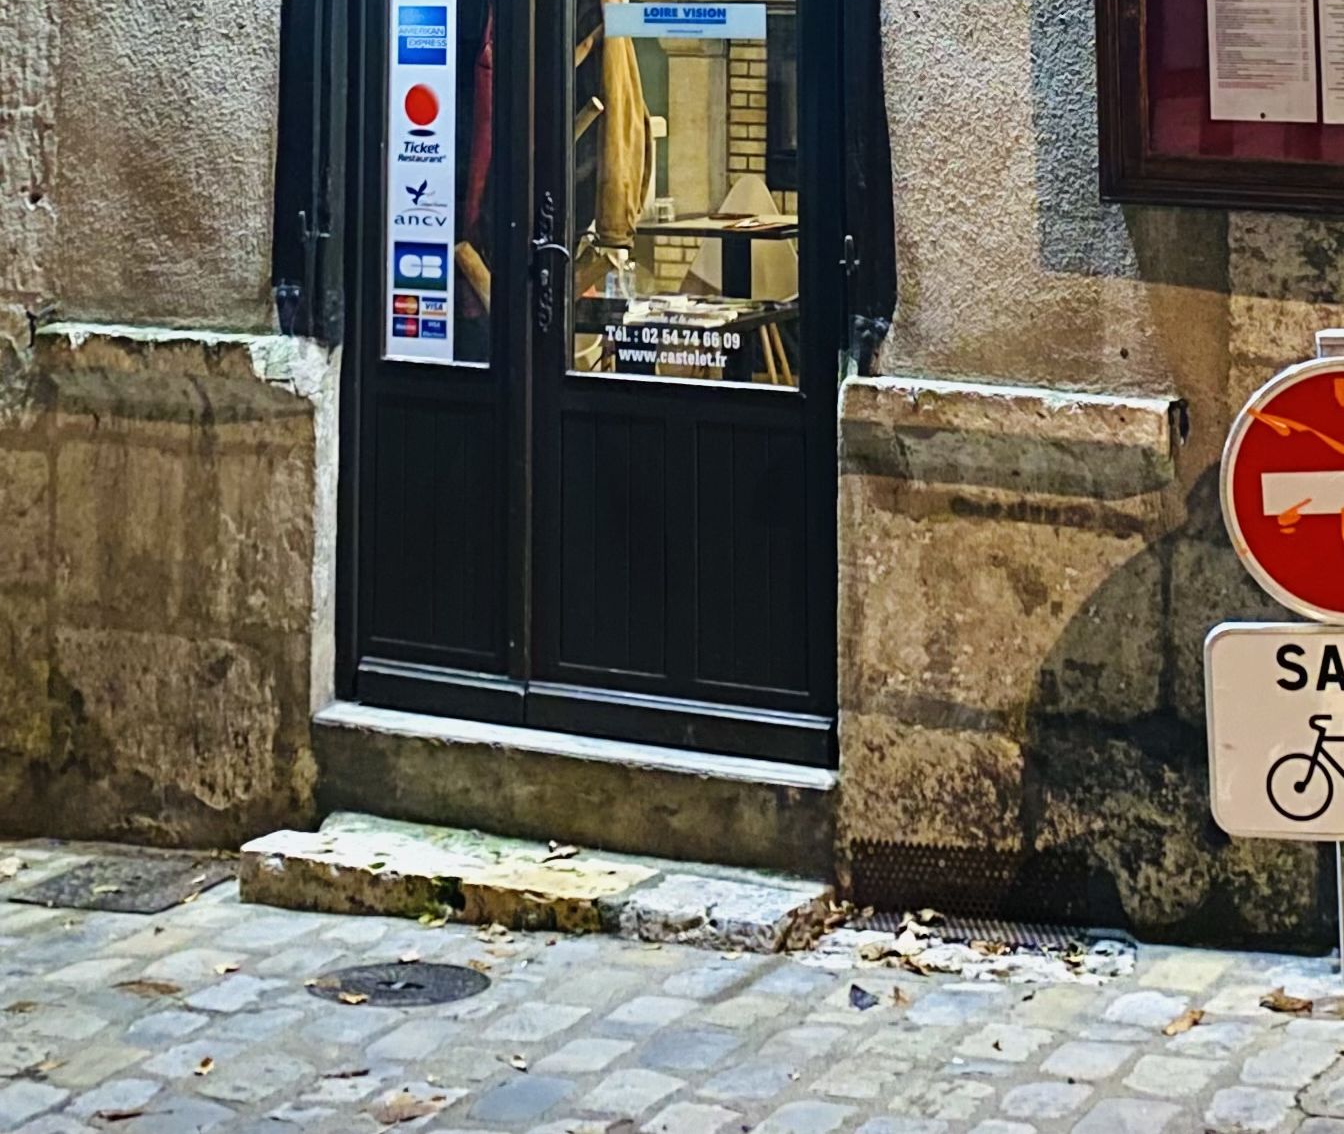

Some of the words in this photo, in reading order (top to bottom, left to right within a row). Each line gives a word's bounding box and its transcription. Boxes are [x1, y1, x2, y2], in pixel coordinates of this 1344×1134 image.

[644, 8, 678, 19] LOIRE
[683, 8, 727, 19] VISION
[408, 39, 447, 48] EXPRESS
[404, 141, 440, 155] Ticket
[394, 215, 447, 227] ancv
[642, 327, 659, 344] 02
[662, 330, 680, 346] 54
[682, 330, 701, 346] 74
[703, 331, 721, 348] 66
[723, 333, 741, 349] 09
[619, 349, 728, 368] www.castelet.fr
